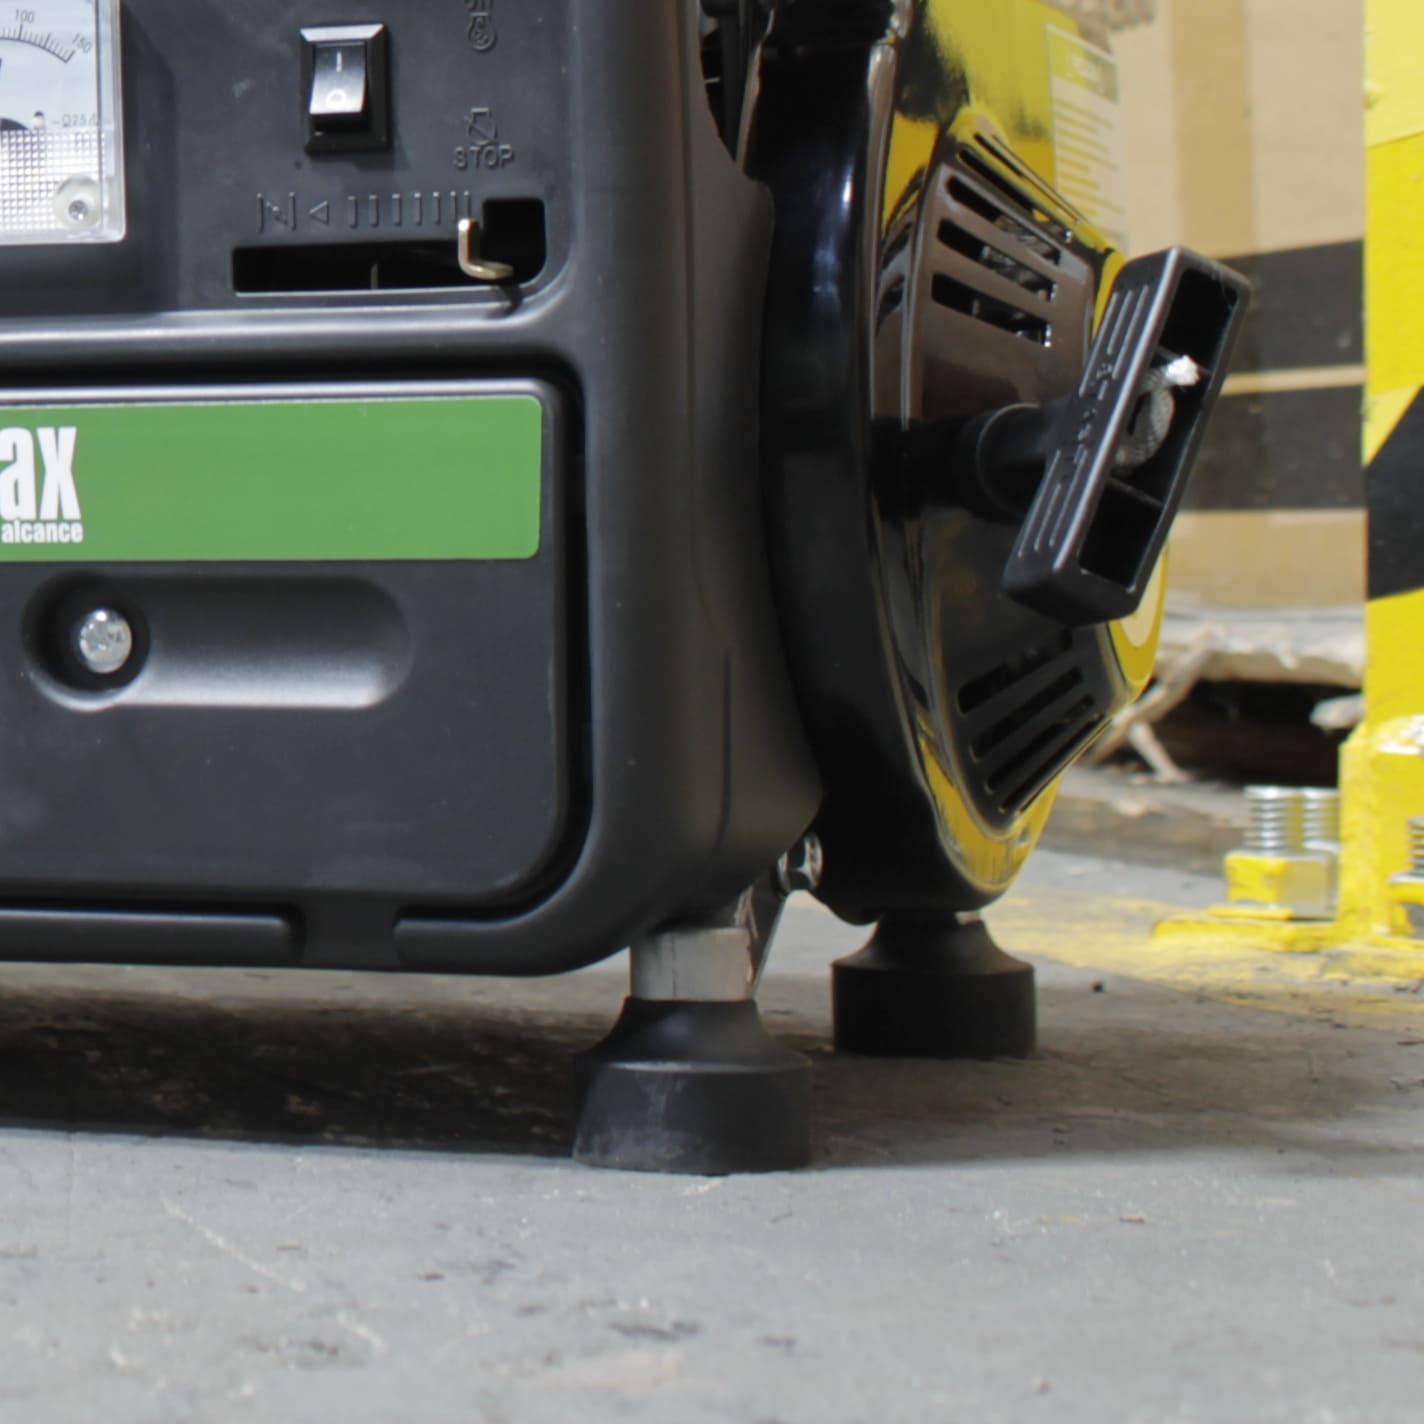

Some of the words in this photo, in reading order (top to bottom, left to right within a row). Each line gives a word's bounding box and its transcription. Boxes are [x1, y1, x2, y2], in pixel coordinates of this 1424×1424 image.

[14, 9, 35, 24] 100
[454, 143, 514, 169] STOP
[2, 521, 84, 544] alcance
